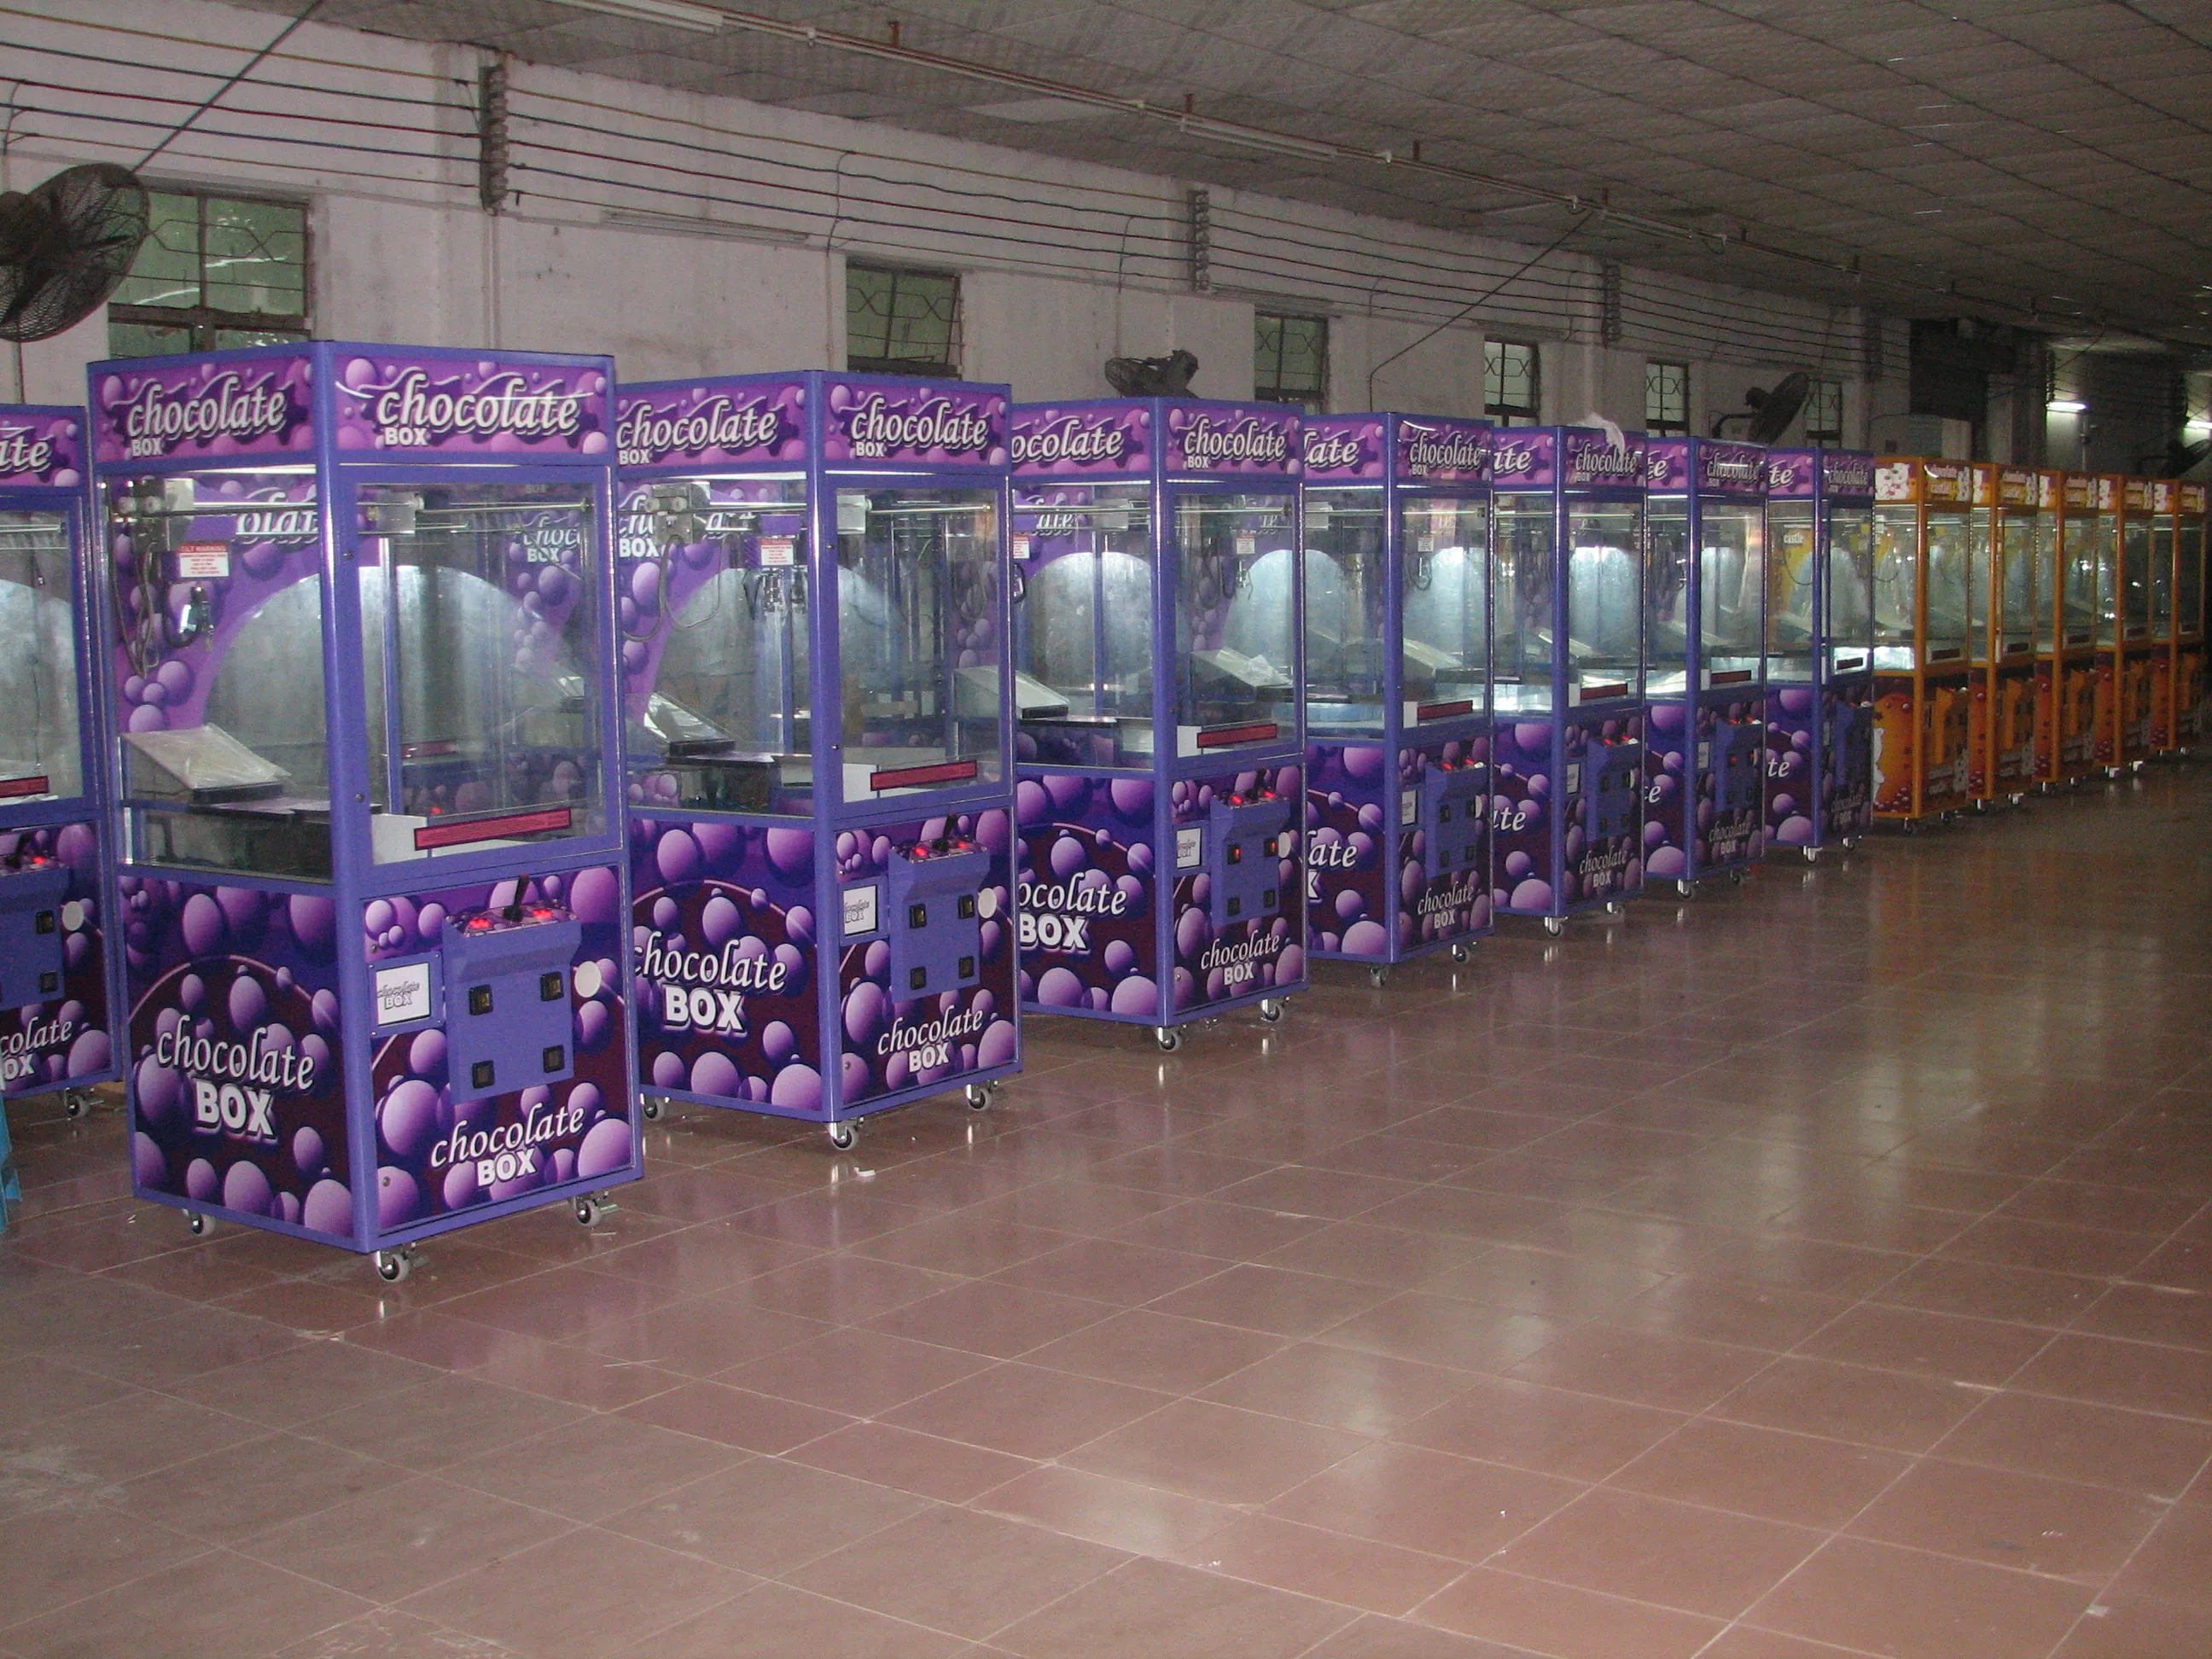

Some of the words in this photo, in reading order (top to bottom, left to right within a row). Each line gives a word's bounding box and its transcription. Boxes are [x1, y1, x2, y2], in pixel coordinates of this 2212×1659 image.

[127, 375, 286, 437] chocolate
[378, 367, 580, 434] chocolate
[385, 427, 428, 446] BOX
[616, 399, 778, 448] chocolate
[852, 398, 987, 445] chocolate
[1184, 415, 1286, 459] chocolate
[131, 437, 164, 457] BOX
[619, 450, 651, 465] BOX
[856, 441, 887, 457] BOX
[1188, 456, 1210, 469] BOX
[1410, 430, 1481, 467] chocolate
[1412, 464, 1428, 475] BOX
[619, 538, 659, 557] BOX
[1580, 845, 1627, 875] chocolate
[1720, 839, 1737, 854] BOX
[1593, 870, 1611, 888] BOX
[1417, 881, 1473, 915] chocolate
[1019, 915, 1088, 950] BOX
[1434, 911, 1455, 929] BOX
[1201, 929, 1279, 970] chocolate
[1224, 961, 1254, 986] BOX
[384, 992, 412, 1010] BOX
[665, 986, 744, 1031] BOX
[878, 1005, 983, 1056] chocolate
[3, 1054, 35, 1080] OX
[157, 1016, 315, 1090] chocolate
[909, 1043, 948, 1073] BOX
[195, 1084, 275, 1138] BOX
[431, 1103, 585, 1167] chocolate
[477, 1150, 536, 1187] BOX
